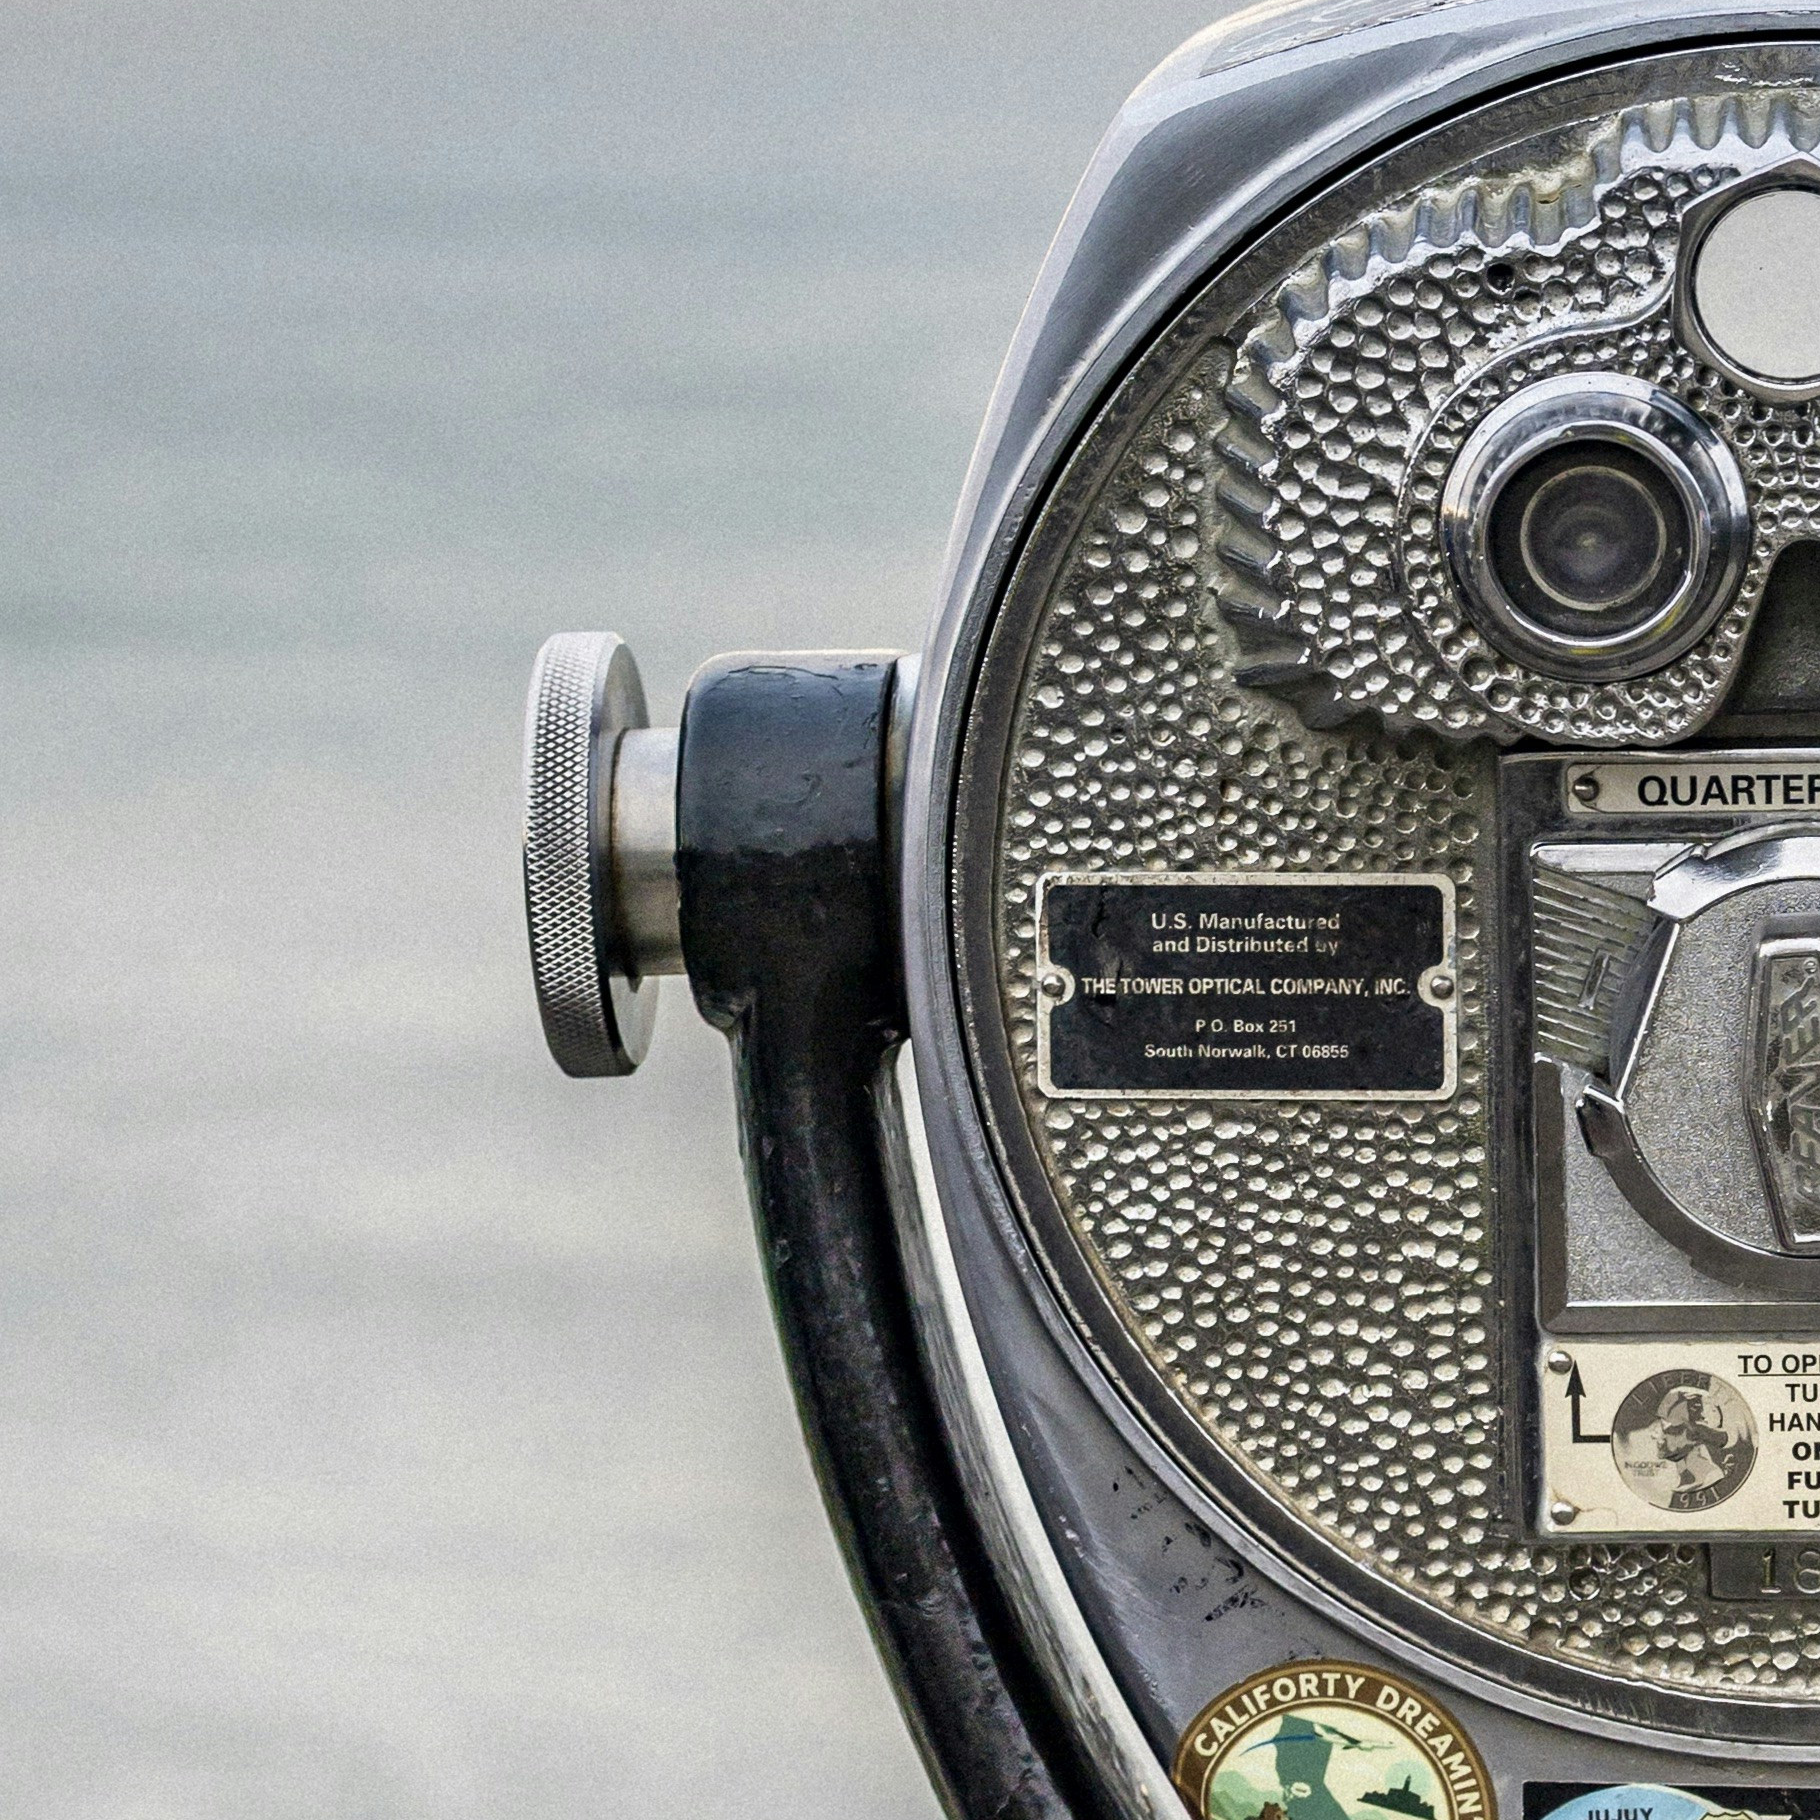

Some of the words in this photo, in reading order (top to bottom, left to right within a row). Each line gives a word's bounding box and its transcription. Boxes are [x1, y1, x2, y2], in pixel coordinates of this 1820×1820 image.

[1151, 912, 1192, 930] U.S.
[1199, 912, 1340, 930] Manufactured
[1152, 936, 1190, 953] and
[1196, 936, 1309, 953] Distributed
[1315, 936, 1339, 956] by
[1081, 977, 1117, 994] THE
[1120, 977, 1183, 995] TOWER
[1188, 977, 1266, 995] OPTICAL
[1270, 977, 1369, 998] COMPANY,
[1374, 977, 1411, 995] INC.
[1233, 1019, 1264, 1033] Box
[1269, 1019, 1296, 1033] 251
[1144, 1044, 1193, 1058] South
[1198, 1044, 1271, 1059] Norwalk,
[1276, 1044, 1298, 1058] CT
[1301, 1044, 1350, 1059] 06855
[1738, 1354, 1774, 1374] TO
[1194, 1672, 1366, 1757] CALIFORTY
